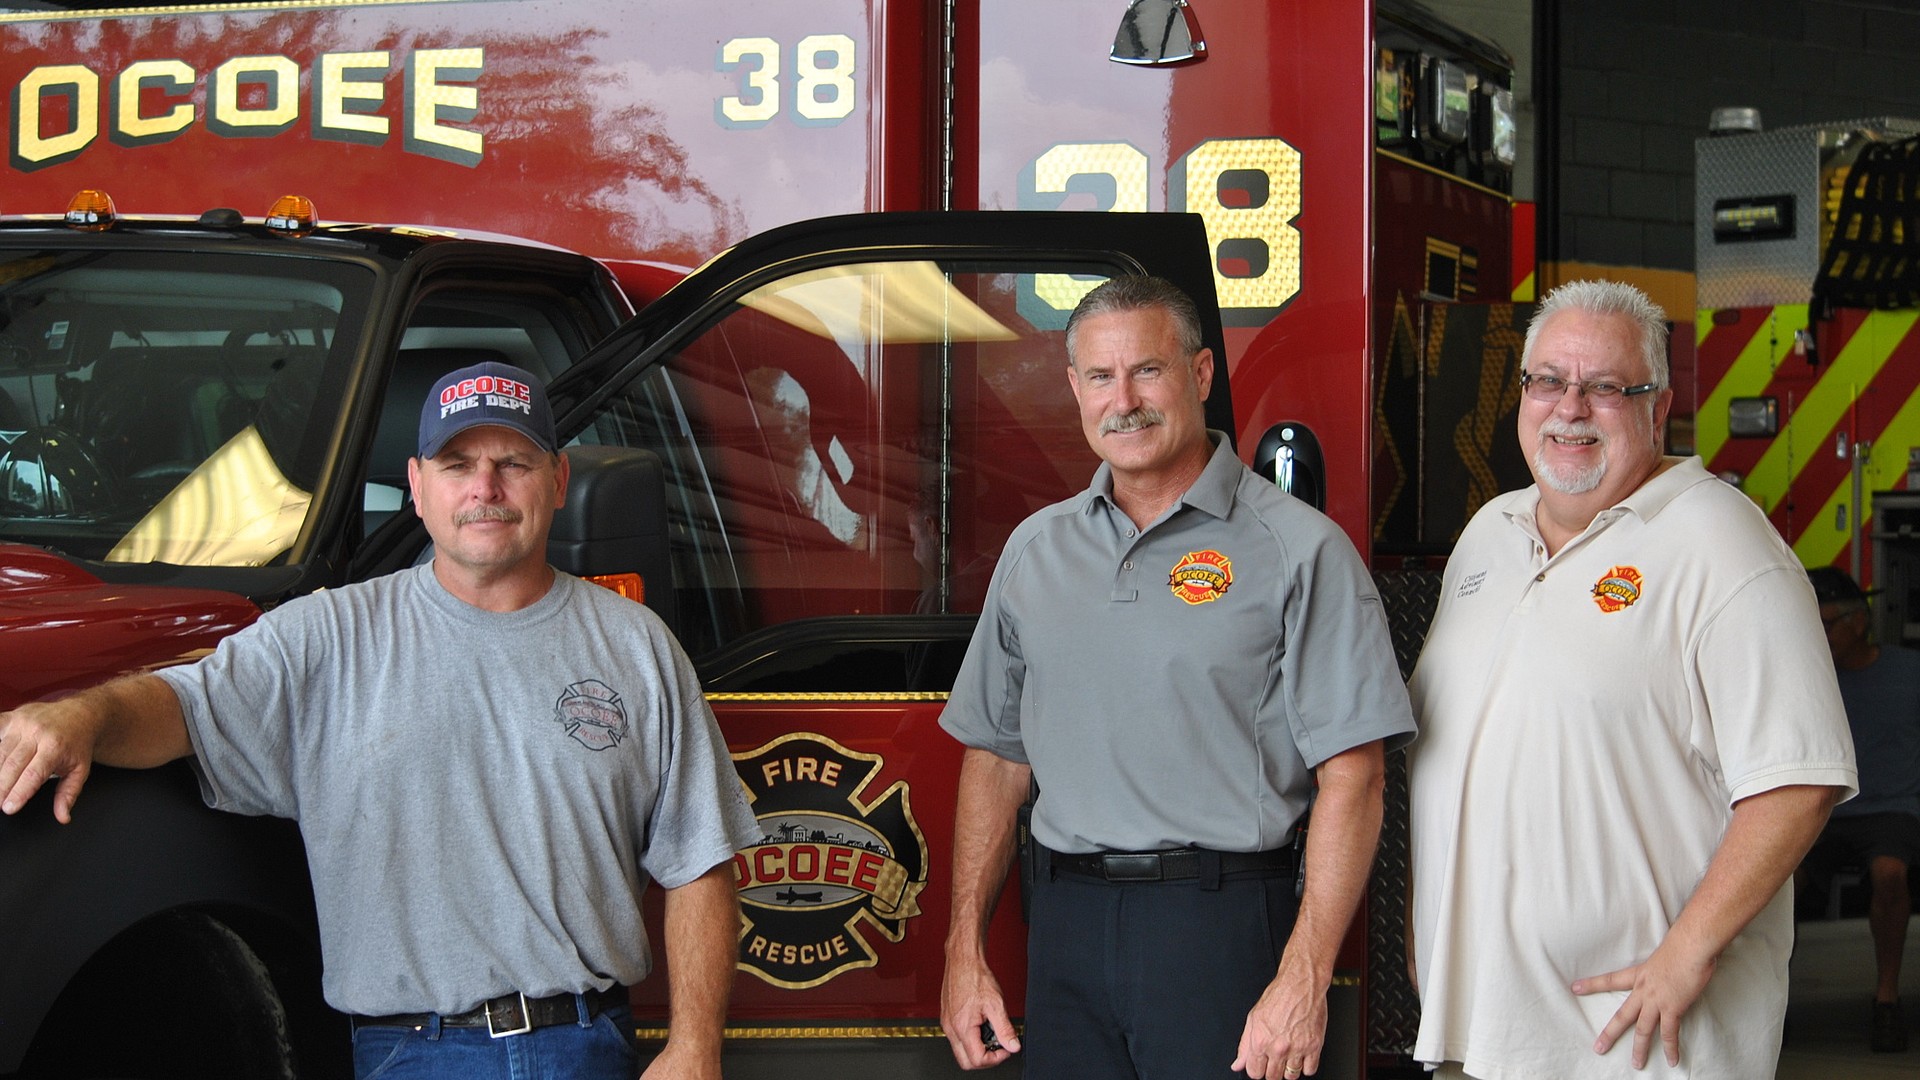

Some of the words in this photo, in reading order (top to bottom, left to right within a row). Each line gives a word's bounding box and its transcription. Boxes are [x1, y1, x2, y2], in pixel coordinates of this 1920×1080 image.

[716, 34, 856, 126] 38
[11, 47, 485, 170] OCOEE
[1025, 137, 1303, 316] 38
[440, 376, 531, 406] OCOEE
[440, 395, 479, 419] FIRE
[485, 394, 531, 415] DEPT
[1195, 553, 1220, 564] FIRE
[1181, 571, 1222, 586] OCOEE
[1181, 588, 1210, 601] RESCUE
[580, 686, 608, 699] FIRE
[569, 706, 618, 726] OCOEE
[762, 757, 843, 788] FIRE
[748, 934, 849, 965] RESCUE
